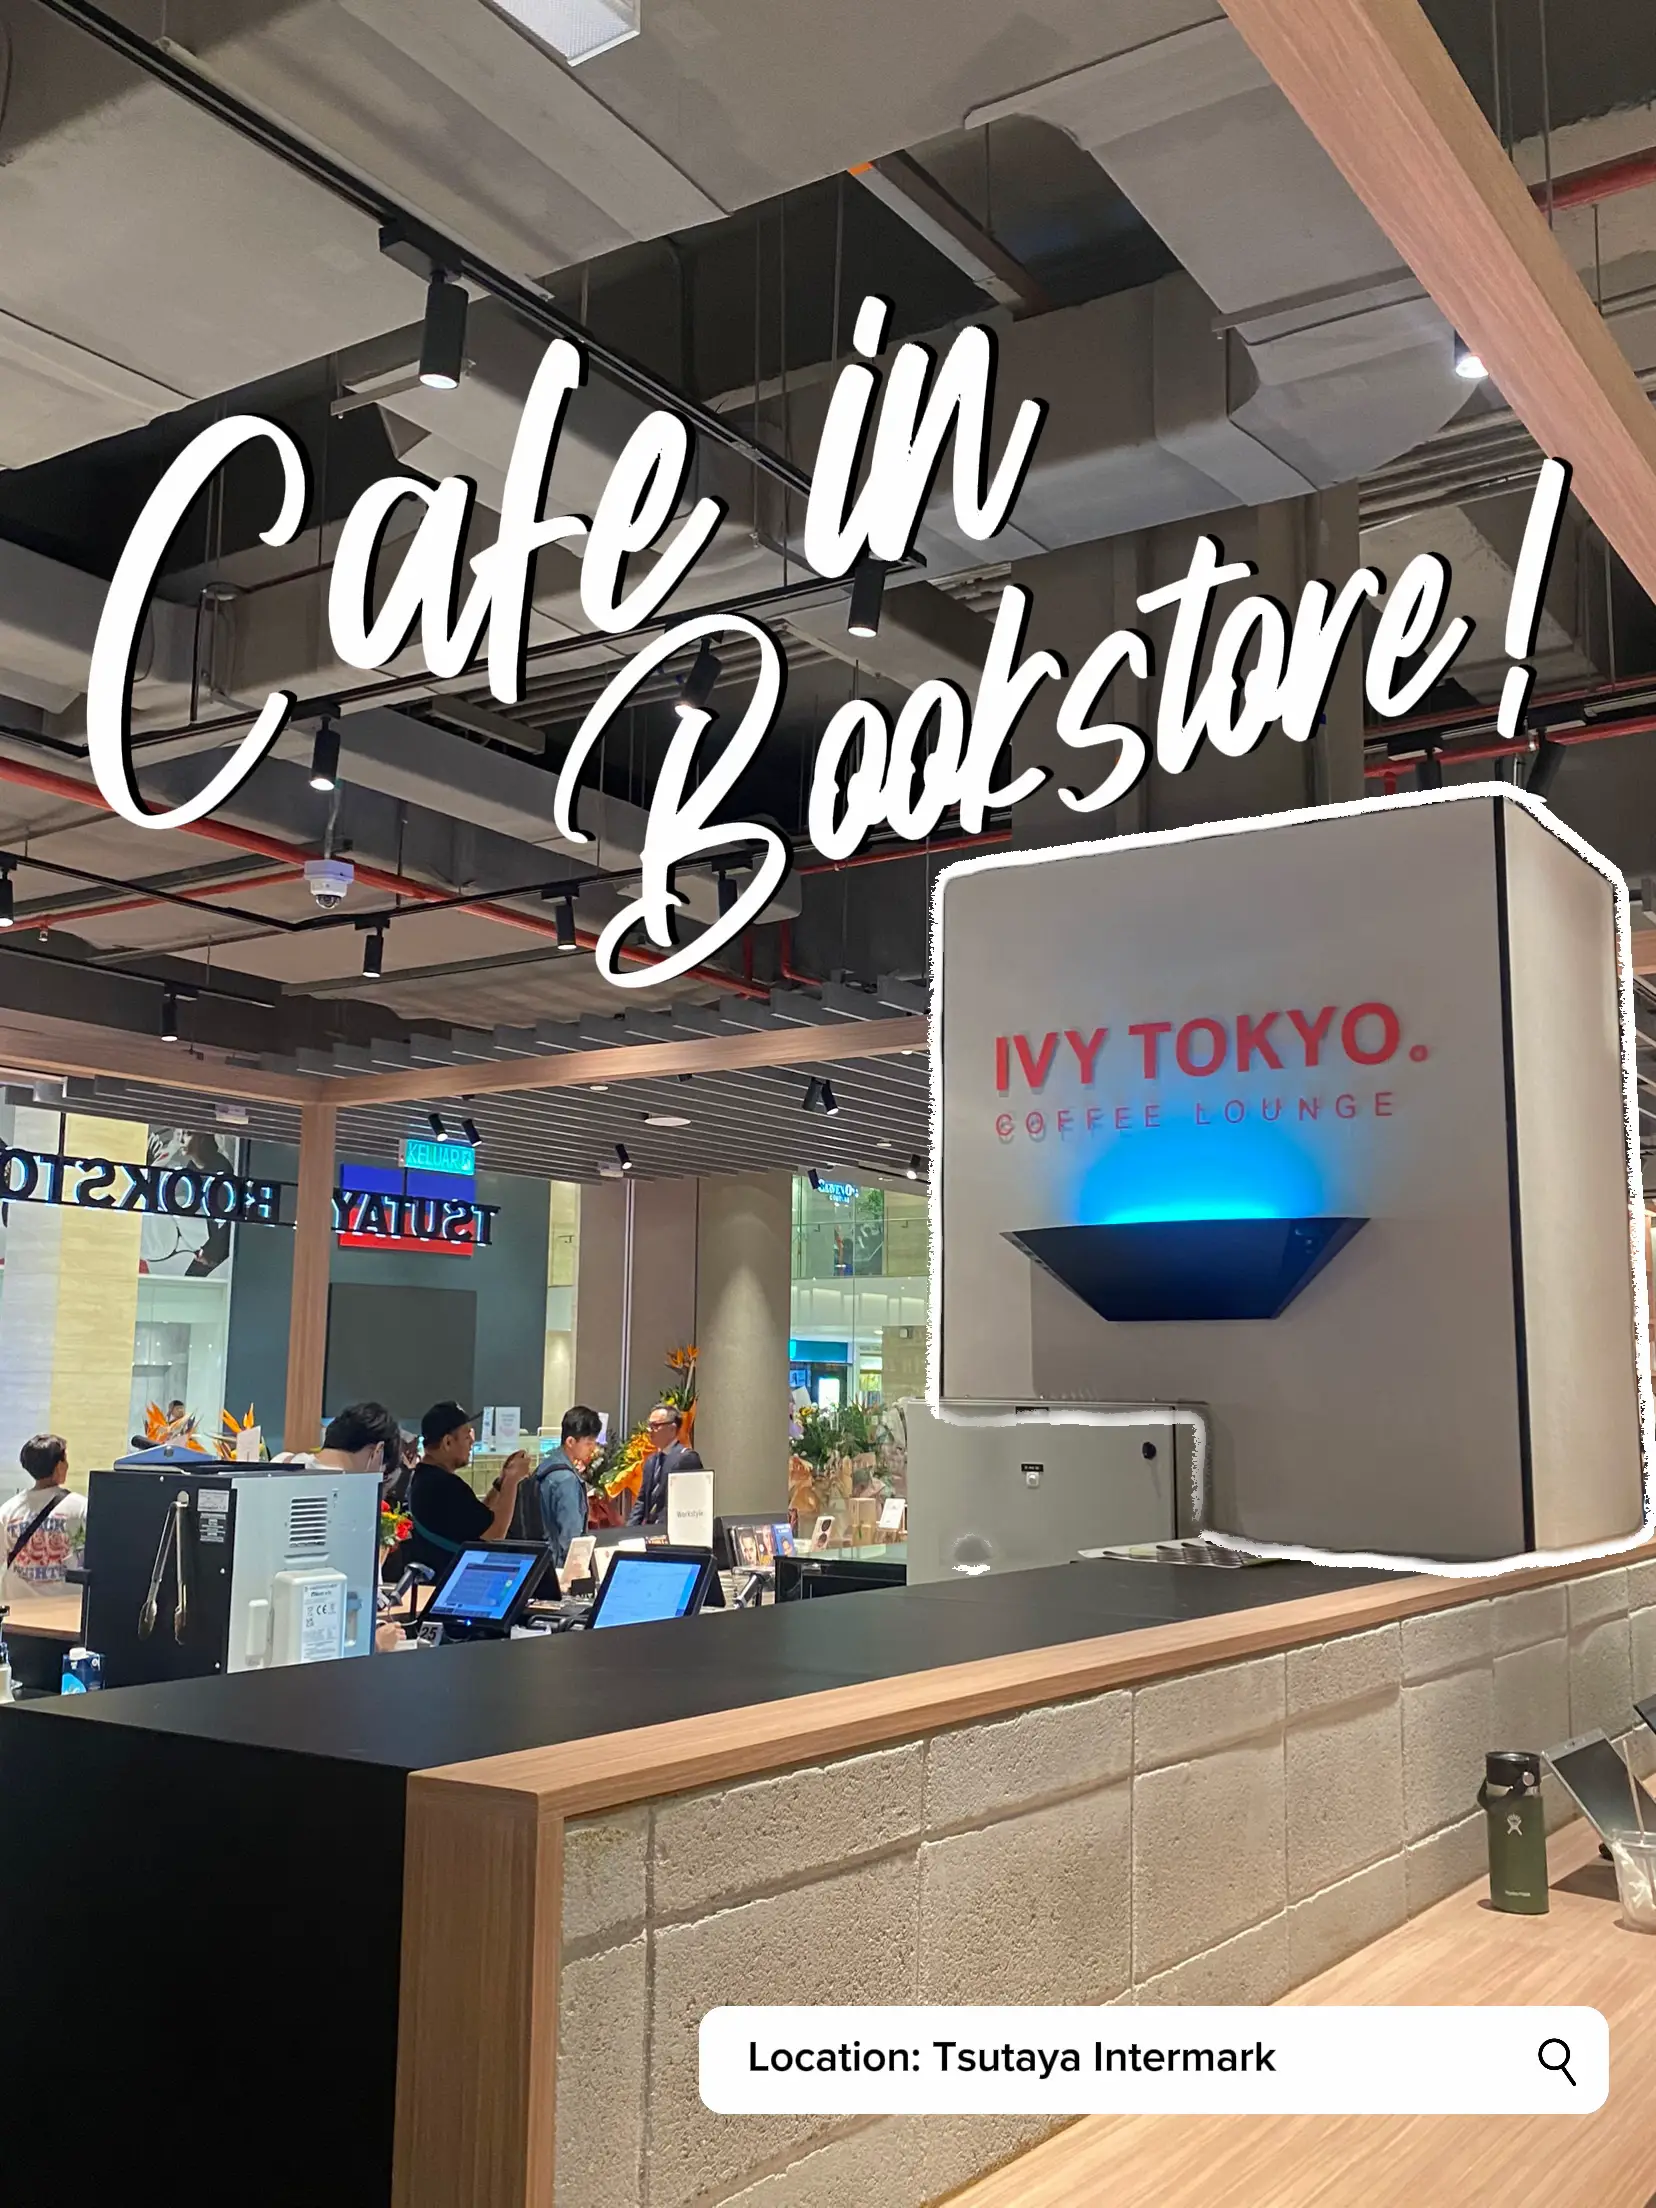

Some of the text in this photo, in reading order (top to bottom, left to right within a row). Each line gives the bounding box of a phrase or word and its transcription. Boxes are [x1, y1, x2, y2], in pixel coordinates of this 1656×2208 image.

[996, 1002, 1428, 1091] IVY TOKYO.
[995, 1091, 1394, 1136] COFFEE LOUNGE
[407, 1142, 461, 1170] KELUAR
[420, 1626, 438, 1641] 25
